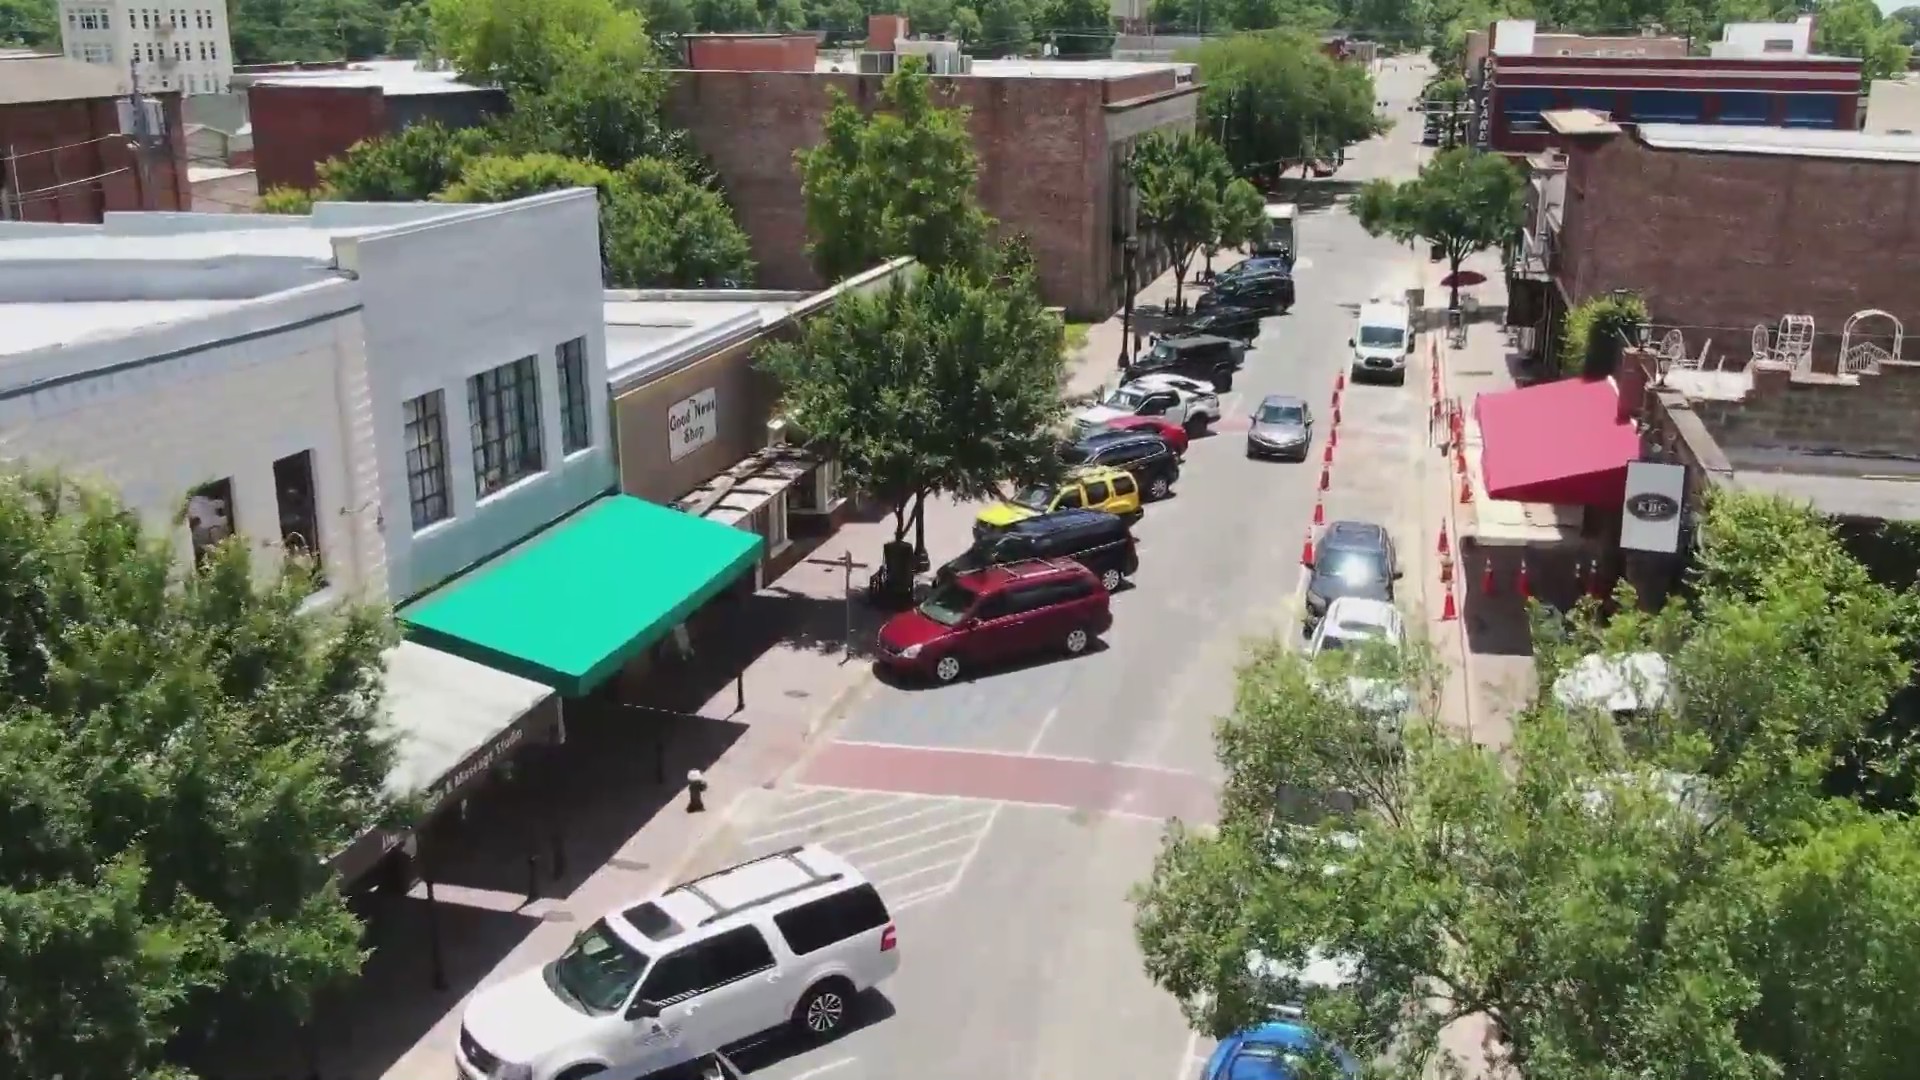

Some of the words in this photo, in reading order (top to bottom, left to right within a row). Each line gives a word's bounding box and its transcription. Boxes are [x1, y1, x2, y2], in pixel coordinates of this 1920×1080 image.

[1482, 57, 1493, 90] EYE
[1479, 97, 1489, 141] CARE
[670, 409, 691, 431] Good
[694, 399, 715, 419] News
[683, 426, 705, 443] Shop
